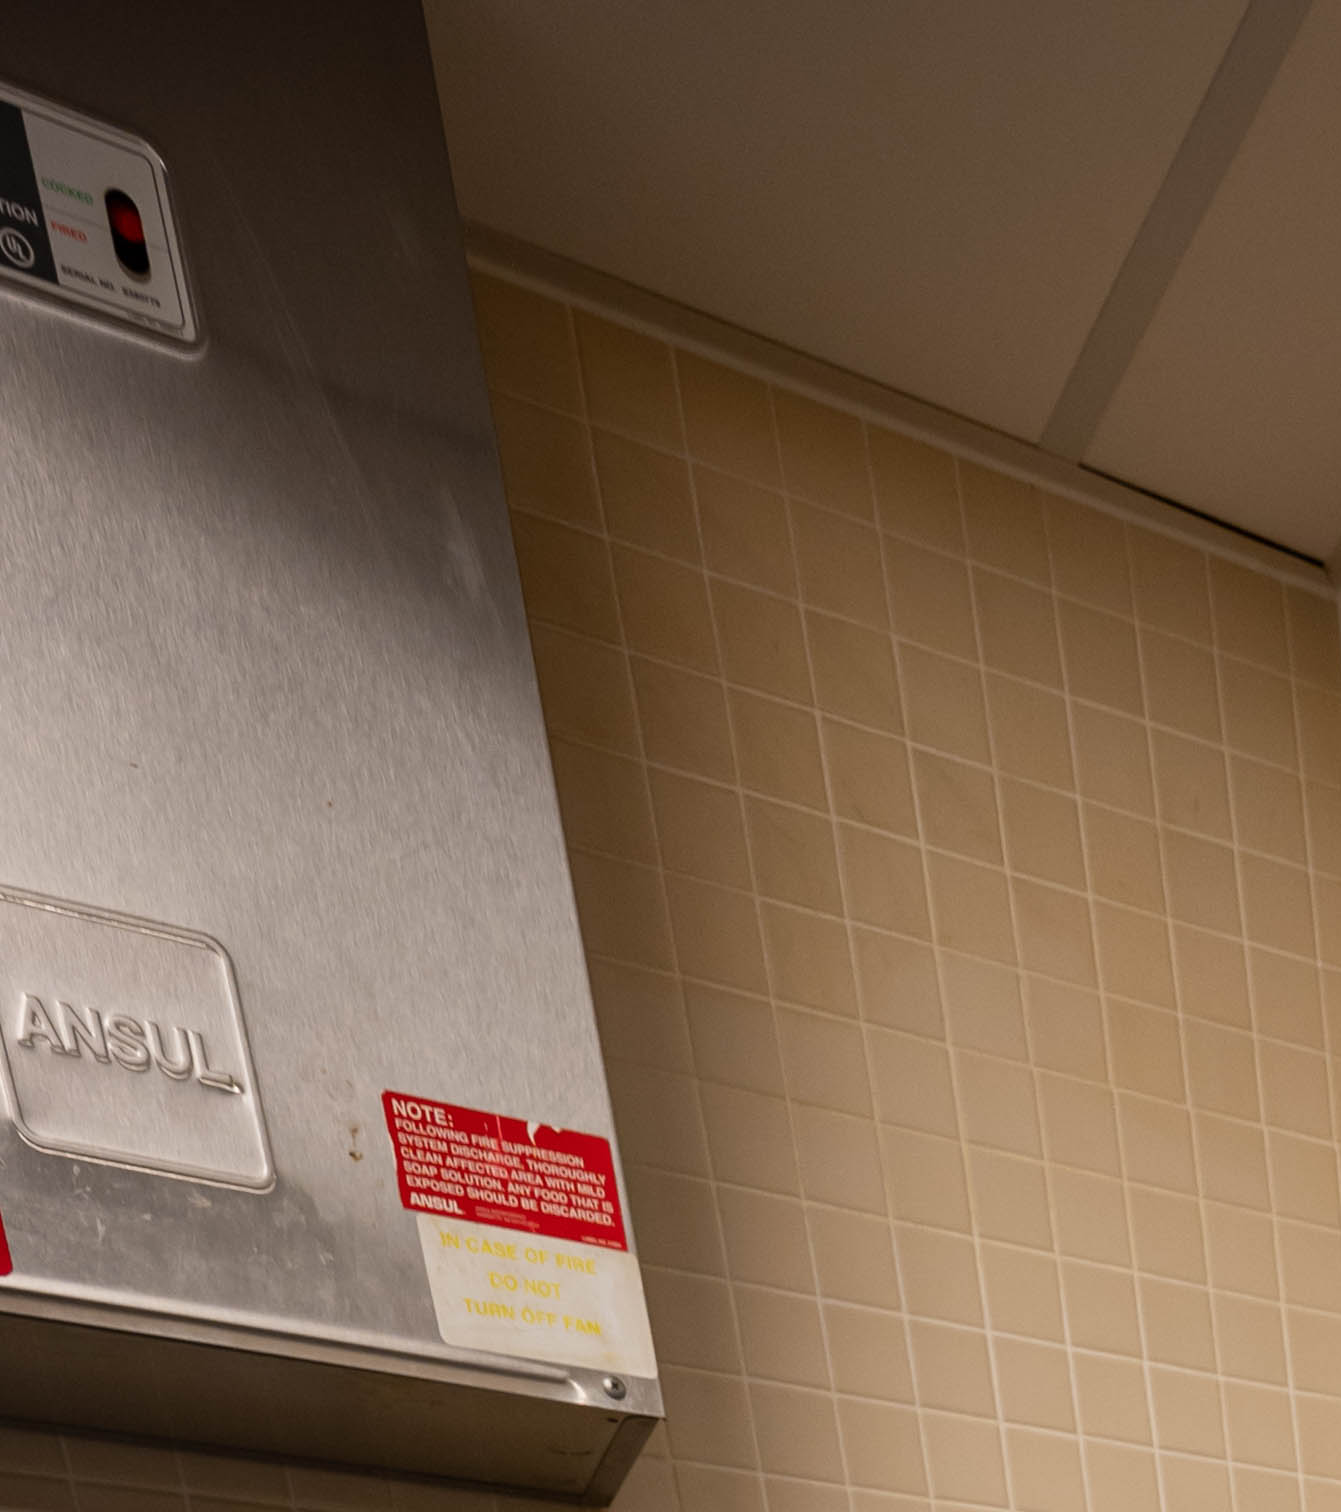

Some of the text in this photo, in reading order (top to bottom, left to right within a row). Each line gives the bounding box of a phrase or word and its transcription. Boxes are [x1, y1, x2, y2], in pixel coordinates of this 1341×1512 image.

[17, 992, 244, 1095] ANSUL
[391, 1097, 454, 1128] NOTE:
[394, 1117, 584, 1168] FOLLOWING FIRE SUPPRESSION
[397, 1131, 448, 1154] SYSTEM
[526, 1158, 606, 1186] THOROUGHLY
[400, 1146, 605, 1199] CLEAN AFFECTED AREA WITH MILD
[403, 1160, 438, 1177] SOAP
[507, 1181, 532, 1197] ANY
[534, 1187, 568, 1203] FOOD
[568, 1194, 598, 1210] THAT
[601, 1200, 614, 1214] IS
[405, 1174, 464, 1196] EXPOSED
[466, 1186, 519, 1208] SHOULD
[521, 1197, 539, 1212] BE
[540, 1201, 616, 1228] DISCARDED.
[410, 1191, 466, 1215] ANSUL
[439, 1231, 597, 1275] IN CASE OF FIRE
[488, 1271, 561, 1299] DO NOT
[464, 1297, 603, 1337] TURN OFF FAN
